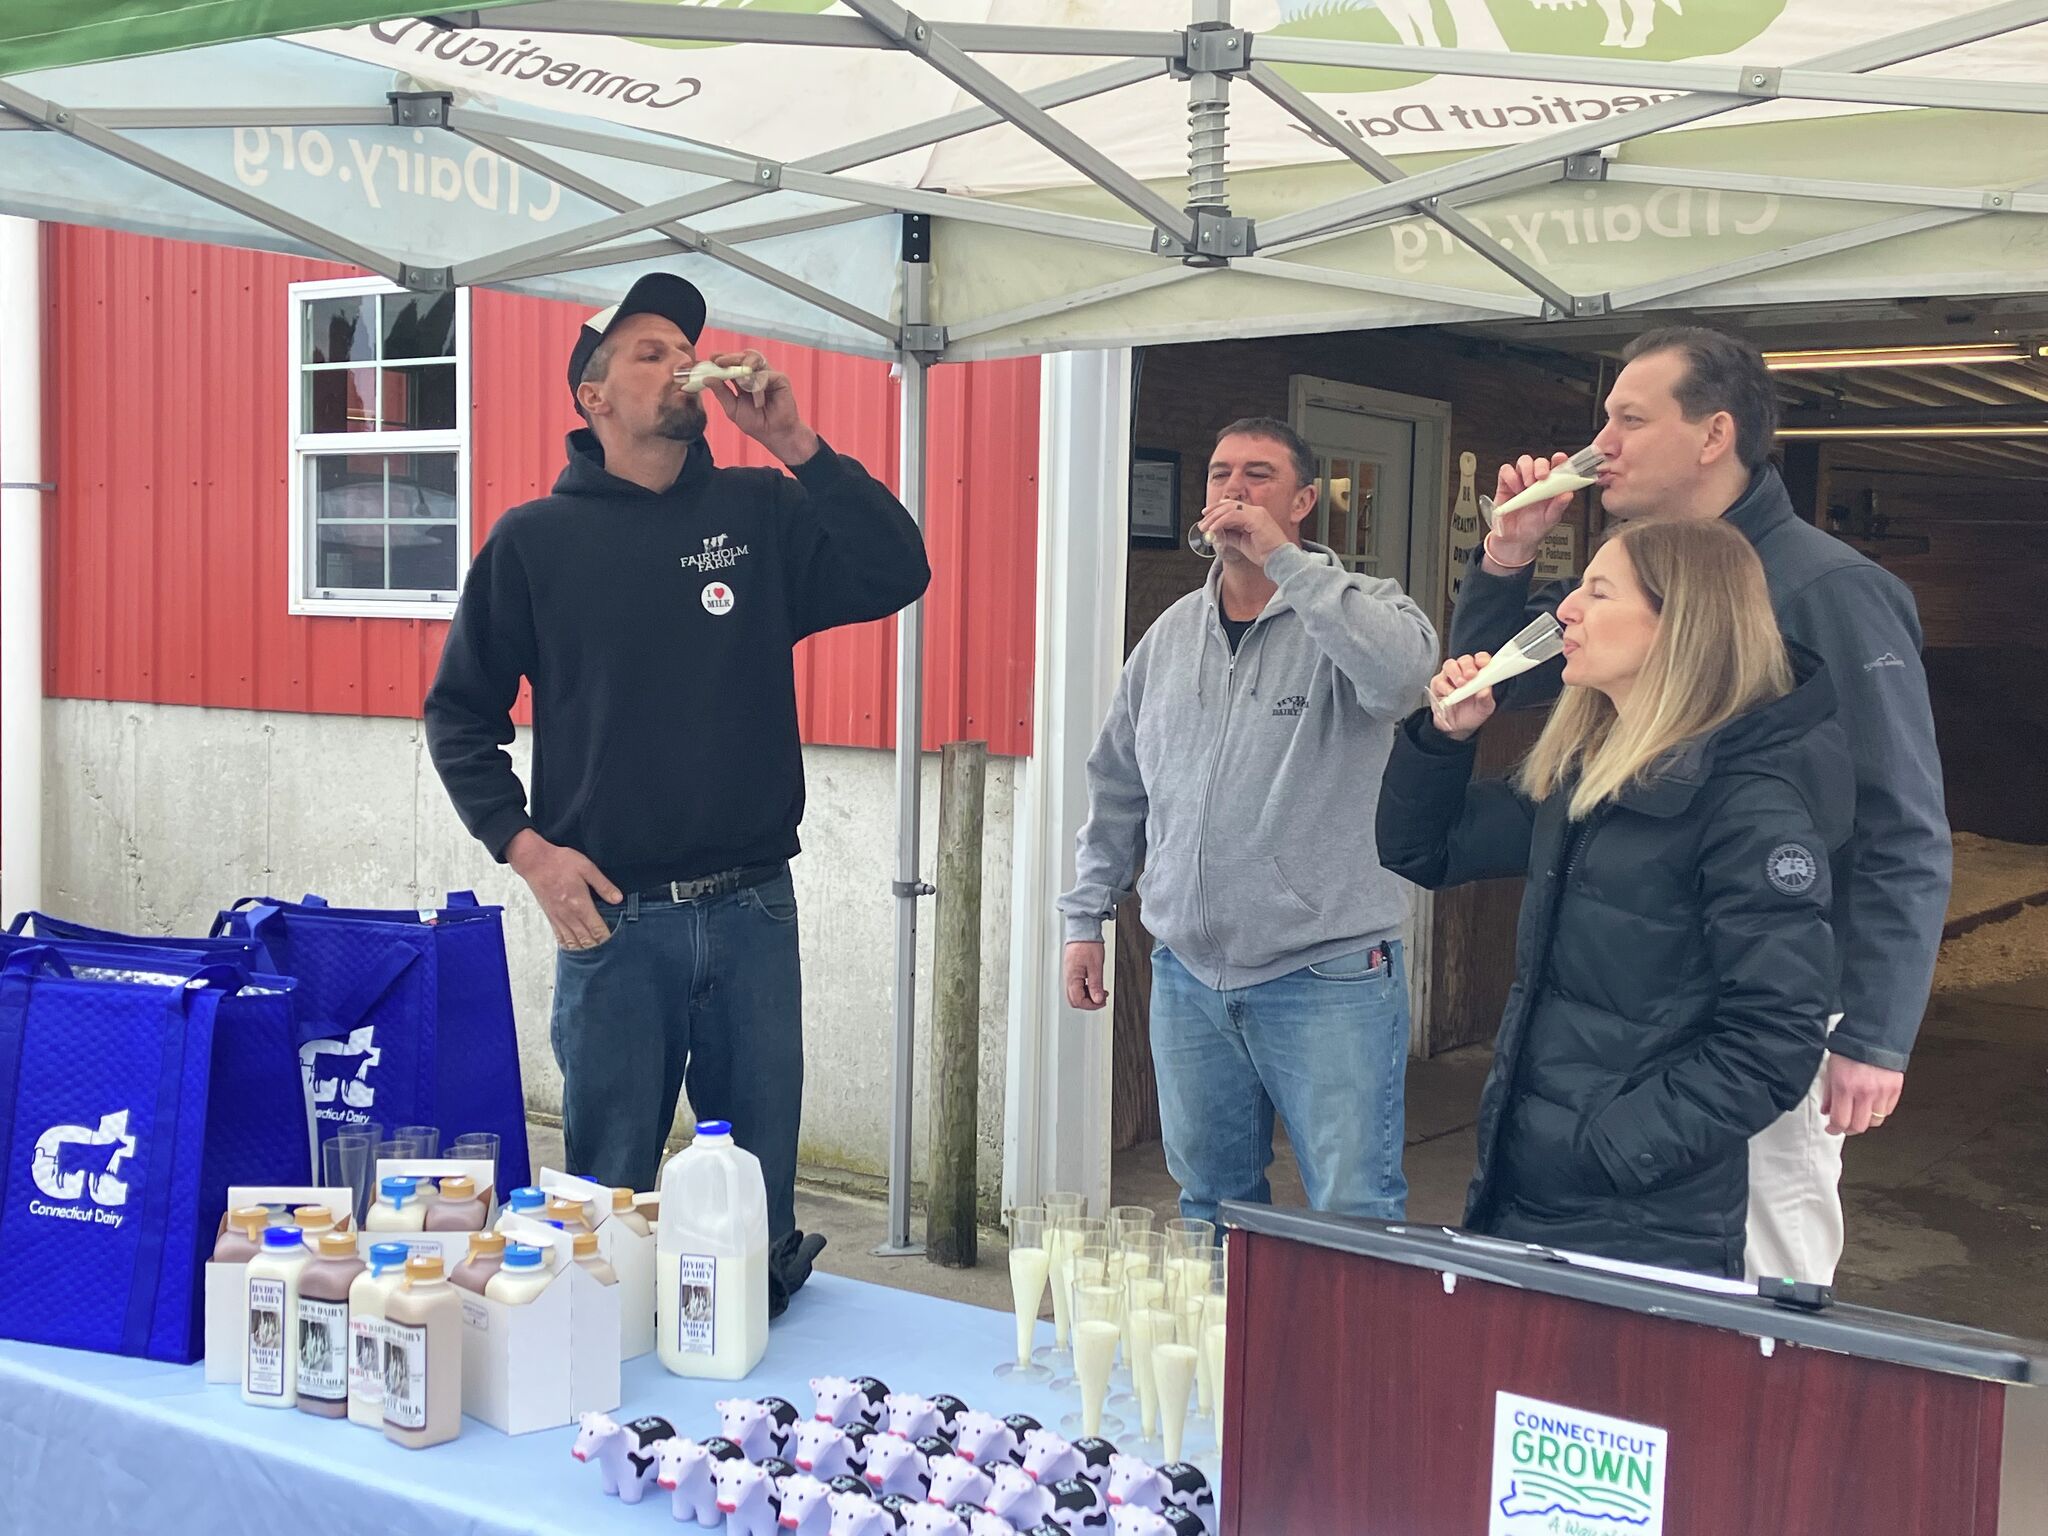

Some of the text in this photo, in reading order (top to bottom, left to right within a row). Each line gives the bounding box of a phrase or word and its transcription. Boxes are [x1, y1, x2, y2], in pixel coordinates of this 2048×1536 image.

[680, 545, 749, 568] FAIRHOLM
[698, 559, 736, 572] FARM
[707, 599, 731, 608] MILK
[345, 1110, 370, 1125] Dairy
[29, 1199, 124, 1229] Connecticut Dairy
[684, 1269, 712, 1279] DAIRY
[253, 1294, 280, 1304] DAIRY
[317, 1306, 344, 1317] DAIRY
[682, 1321, 711, 1330] WHOLE
[686, 1329, 707, 1338] MILK
[251, 1348, 280, 1357] WHOLE
[255, 1356, 276, 1366] MILK
[1514, 1410, 1657, 1457] CONNECTICUT
[1512, 1429, 1652, 1495] GROWN
[1548, 1515, 1560, 1533] A
